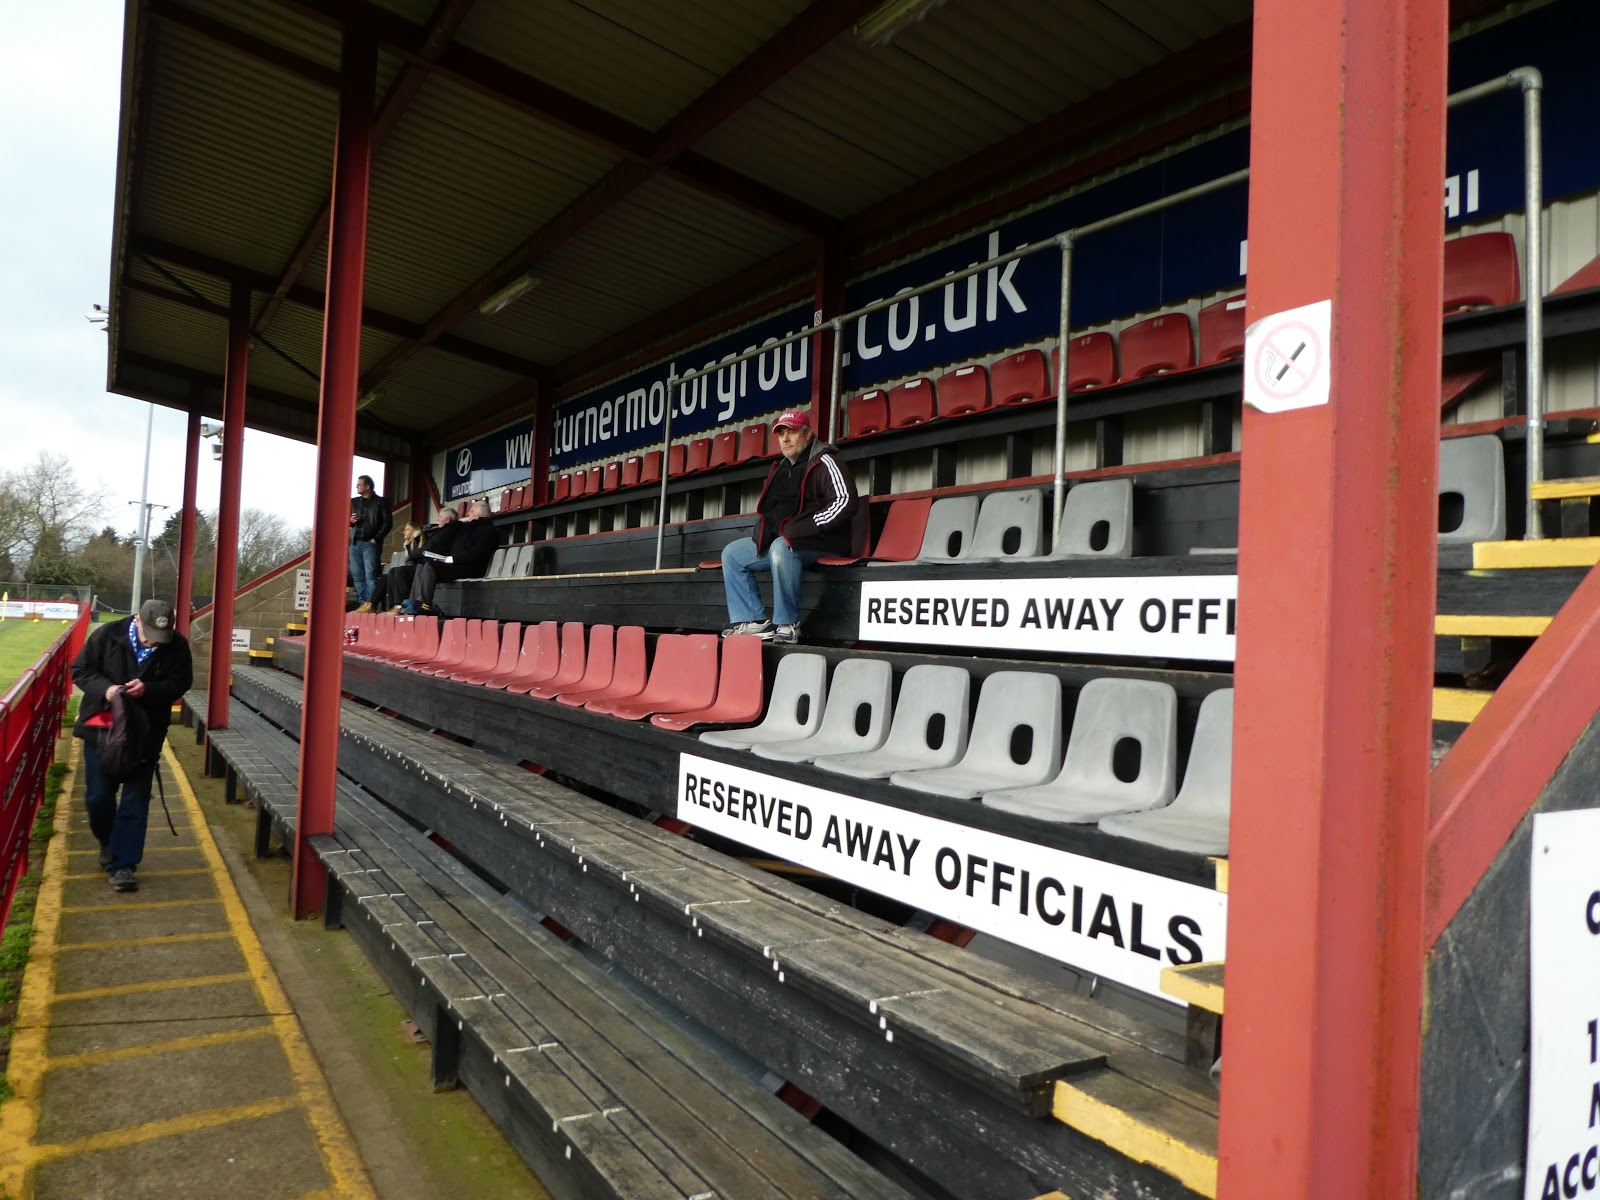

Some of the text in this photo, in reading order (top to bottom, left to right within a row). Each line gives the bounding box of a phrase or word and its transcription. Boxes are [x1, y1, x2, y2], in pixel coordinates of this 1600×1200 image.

[867, 598, 1236, 636] RESERVED AWAY OFFI
[685, 772, 1203, 966] RESERVED AWAY OFFICIALS
